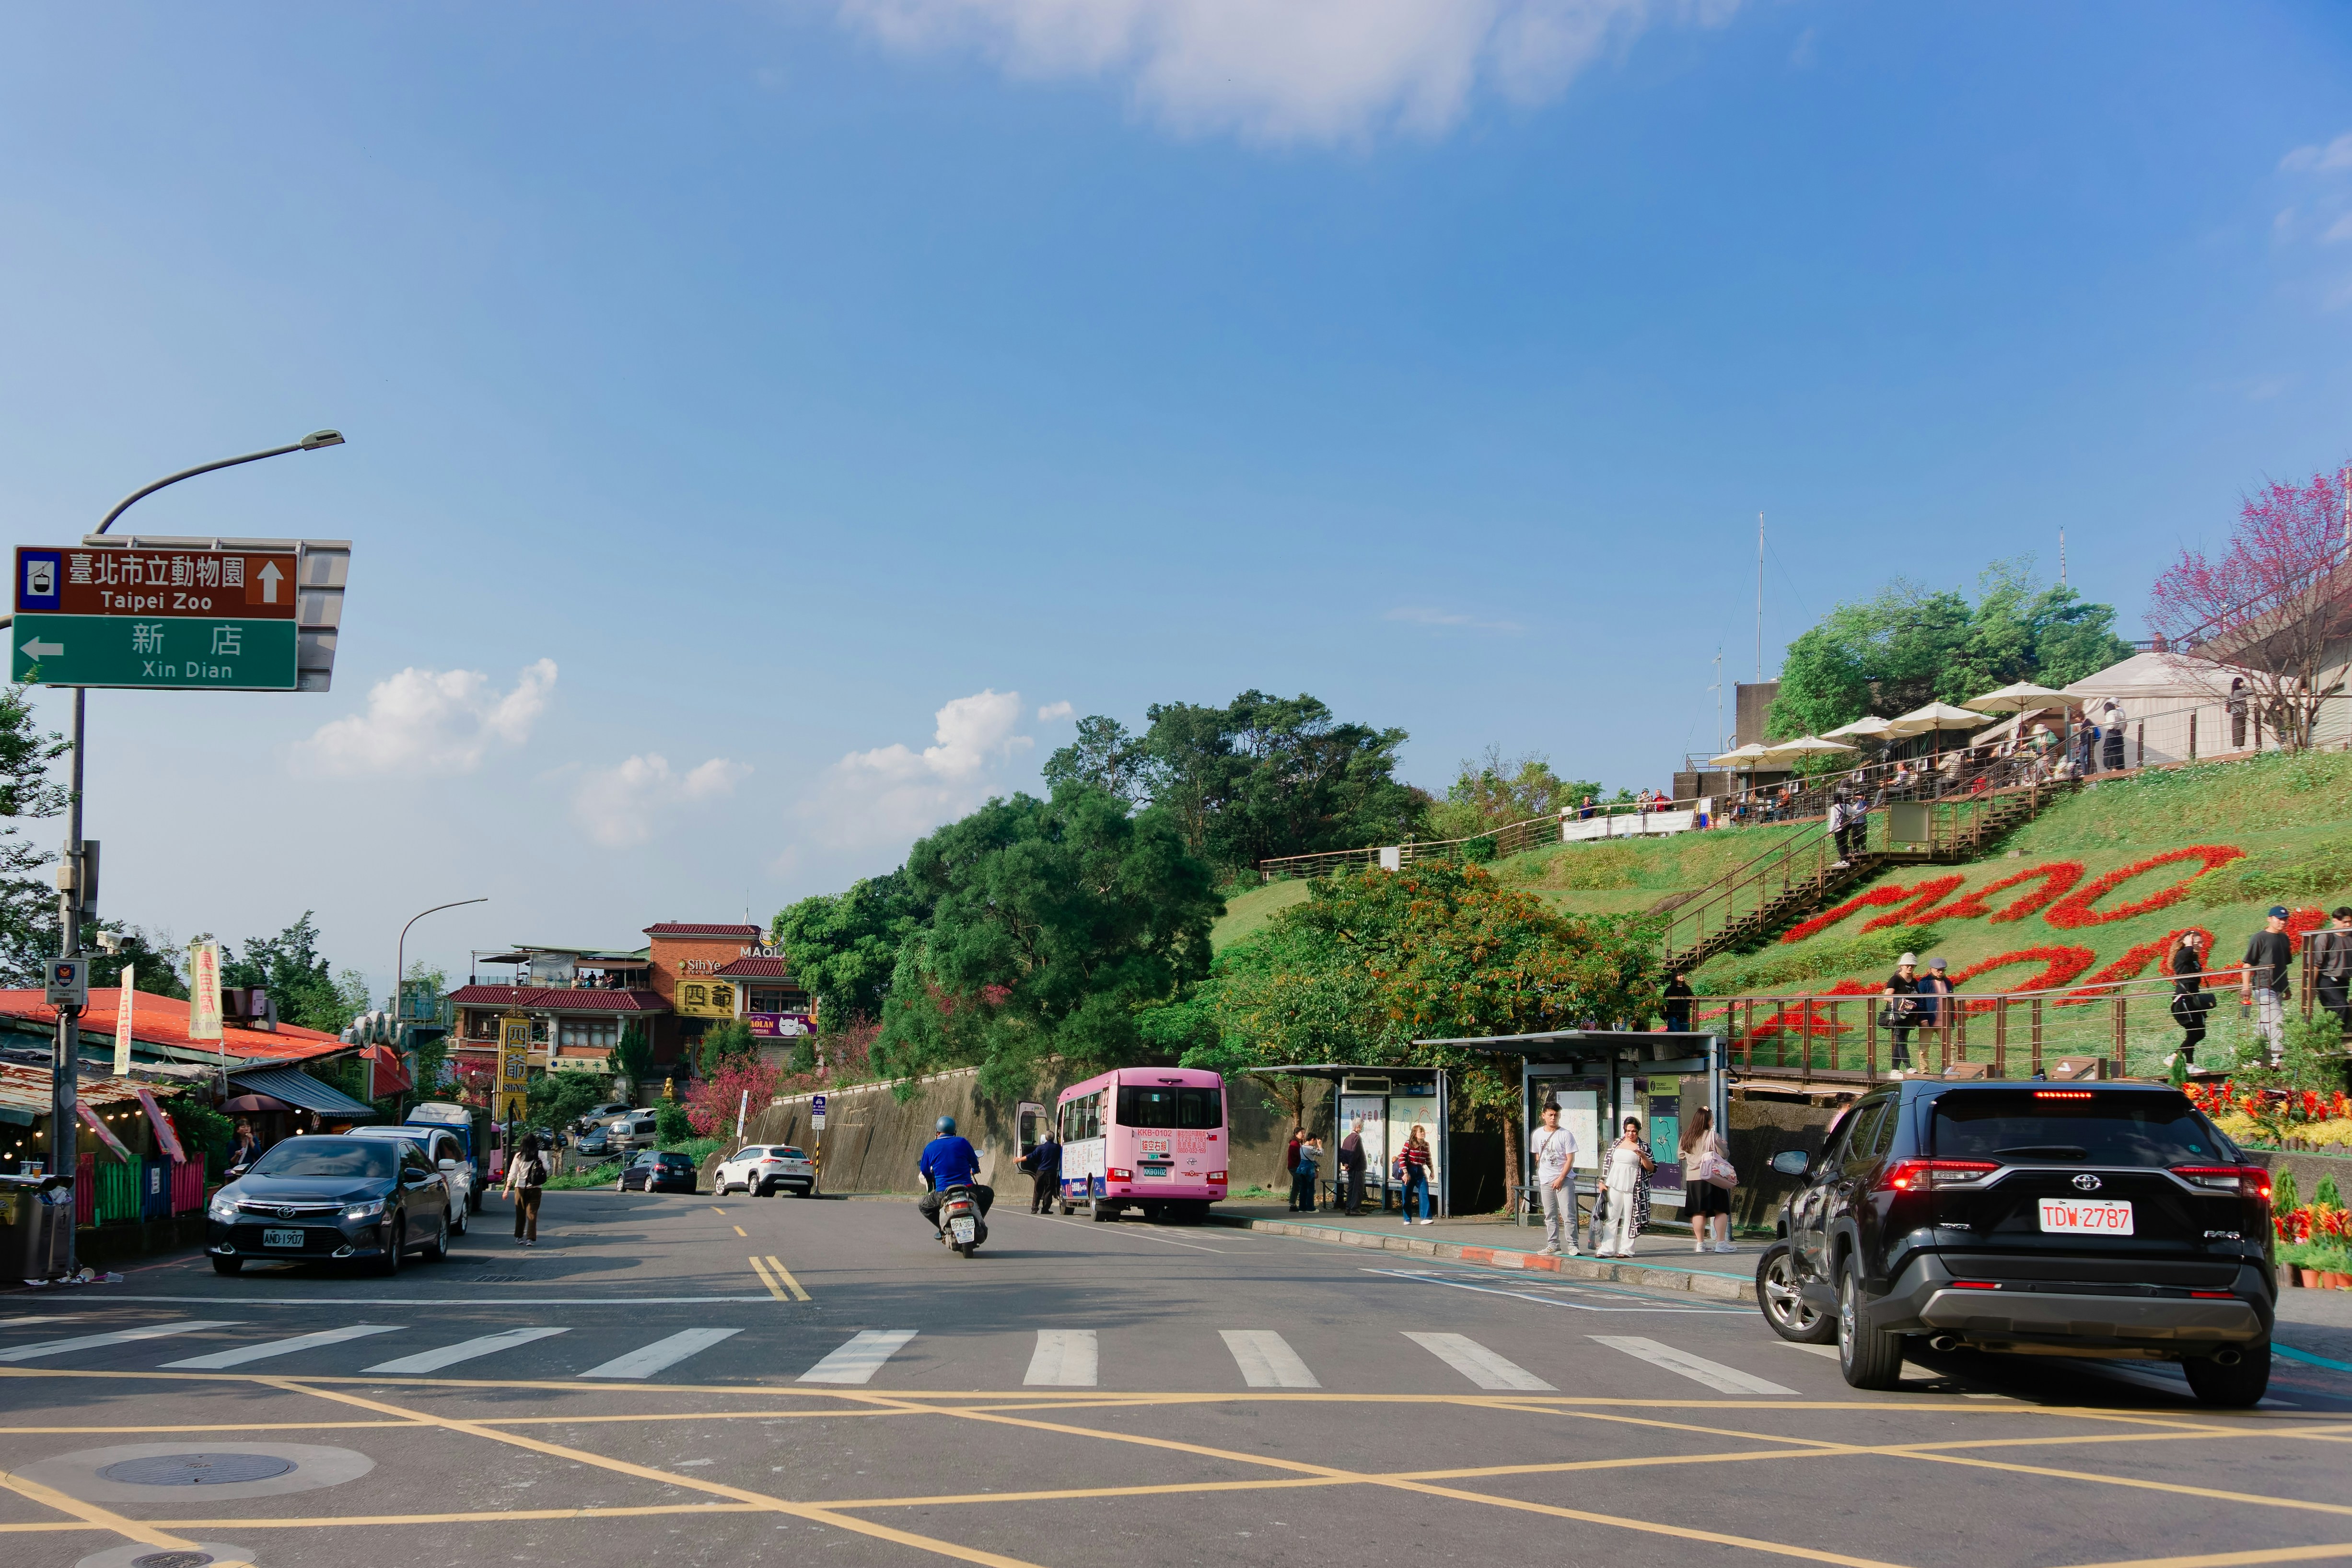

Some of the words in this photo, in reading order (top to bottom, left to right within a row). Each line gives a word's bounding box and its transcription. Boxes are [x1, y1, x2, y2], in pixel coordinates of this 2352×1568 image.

[69, 553, 245, 588] 臺北市立動物園
[101, 591, 164, 612] Taipei
[173, 592, 212, 610] Zoo
[142, 661, 175, 677] Xin
[186, 662, 232, 678] Dian
[740, 946, 786, 958] MAOL
[687, 959, 705, 970] Sih
[707, 960, 721, 970] Ye
[504, 1084, 516, 1092] Sih
[517, 1084, 526, 1092] Ye
[1142, 1140, 1167, 1151] 貓空右線
[2043, 1207, 2129, 1228] TDW-2787
[264, 1233, 303, 1244] AND-1907
